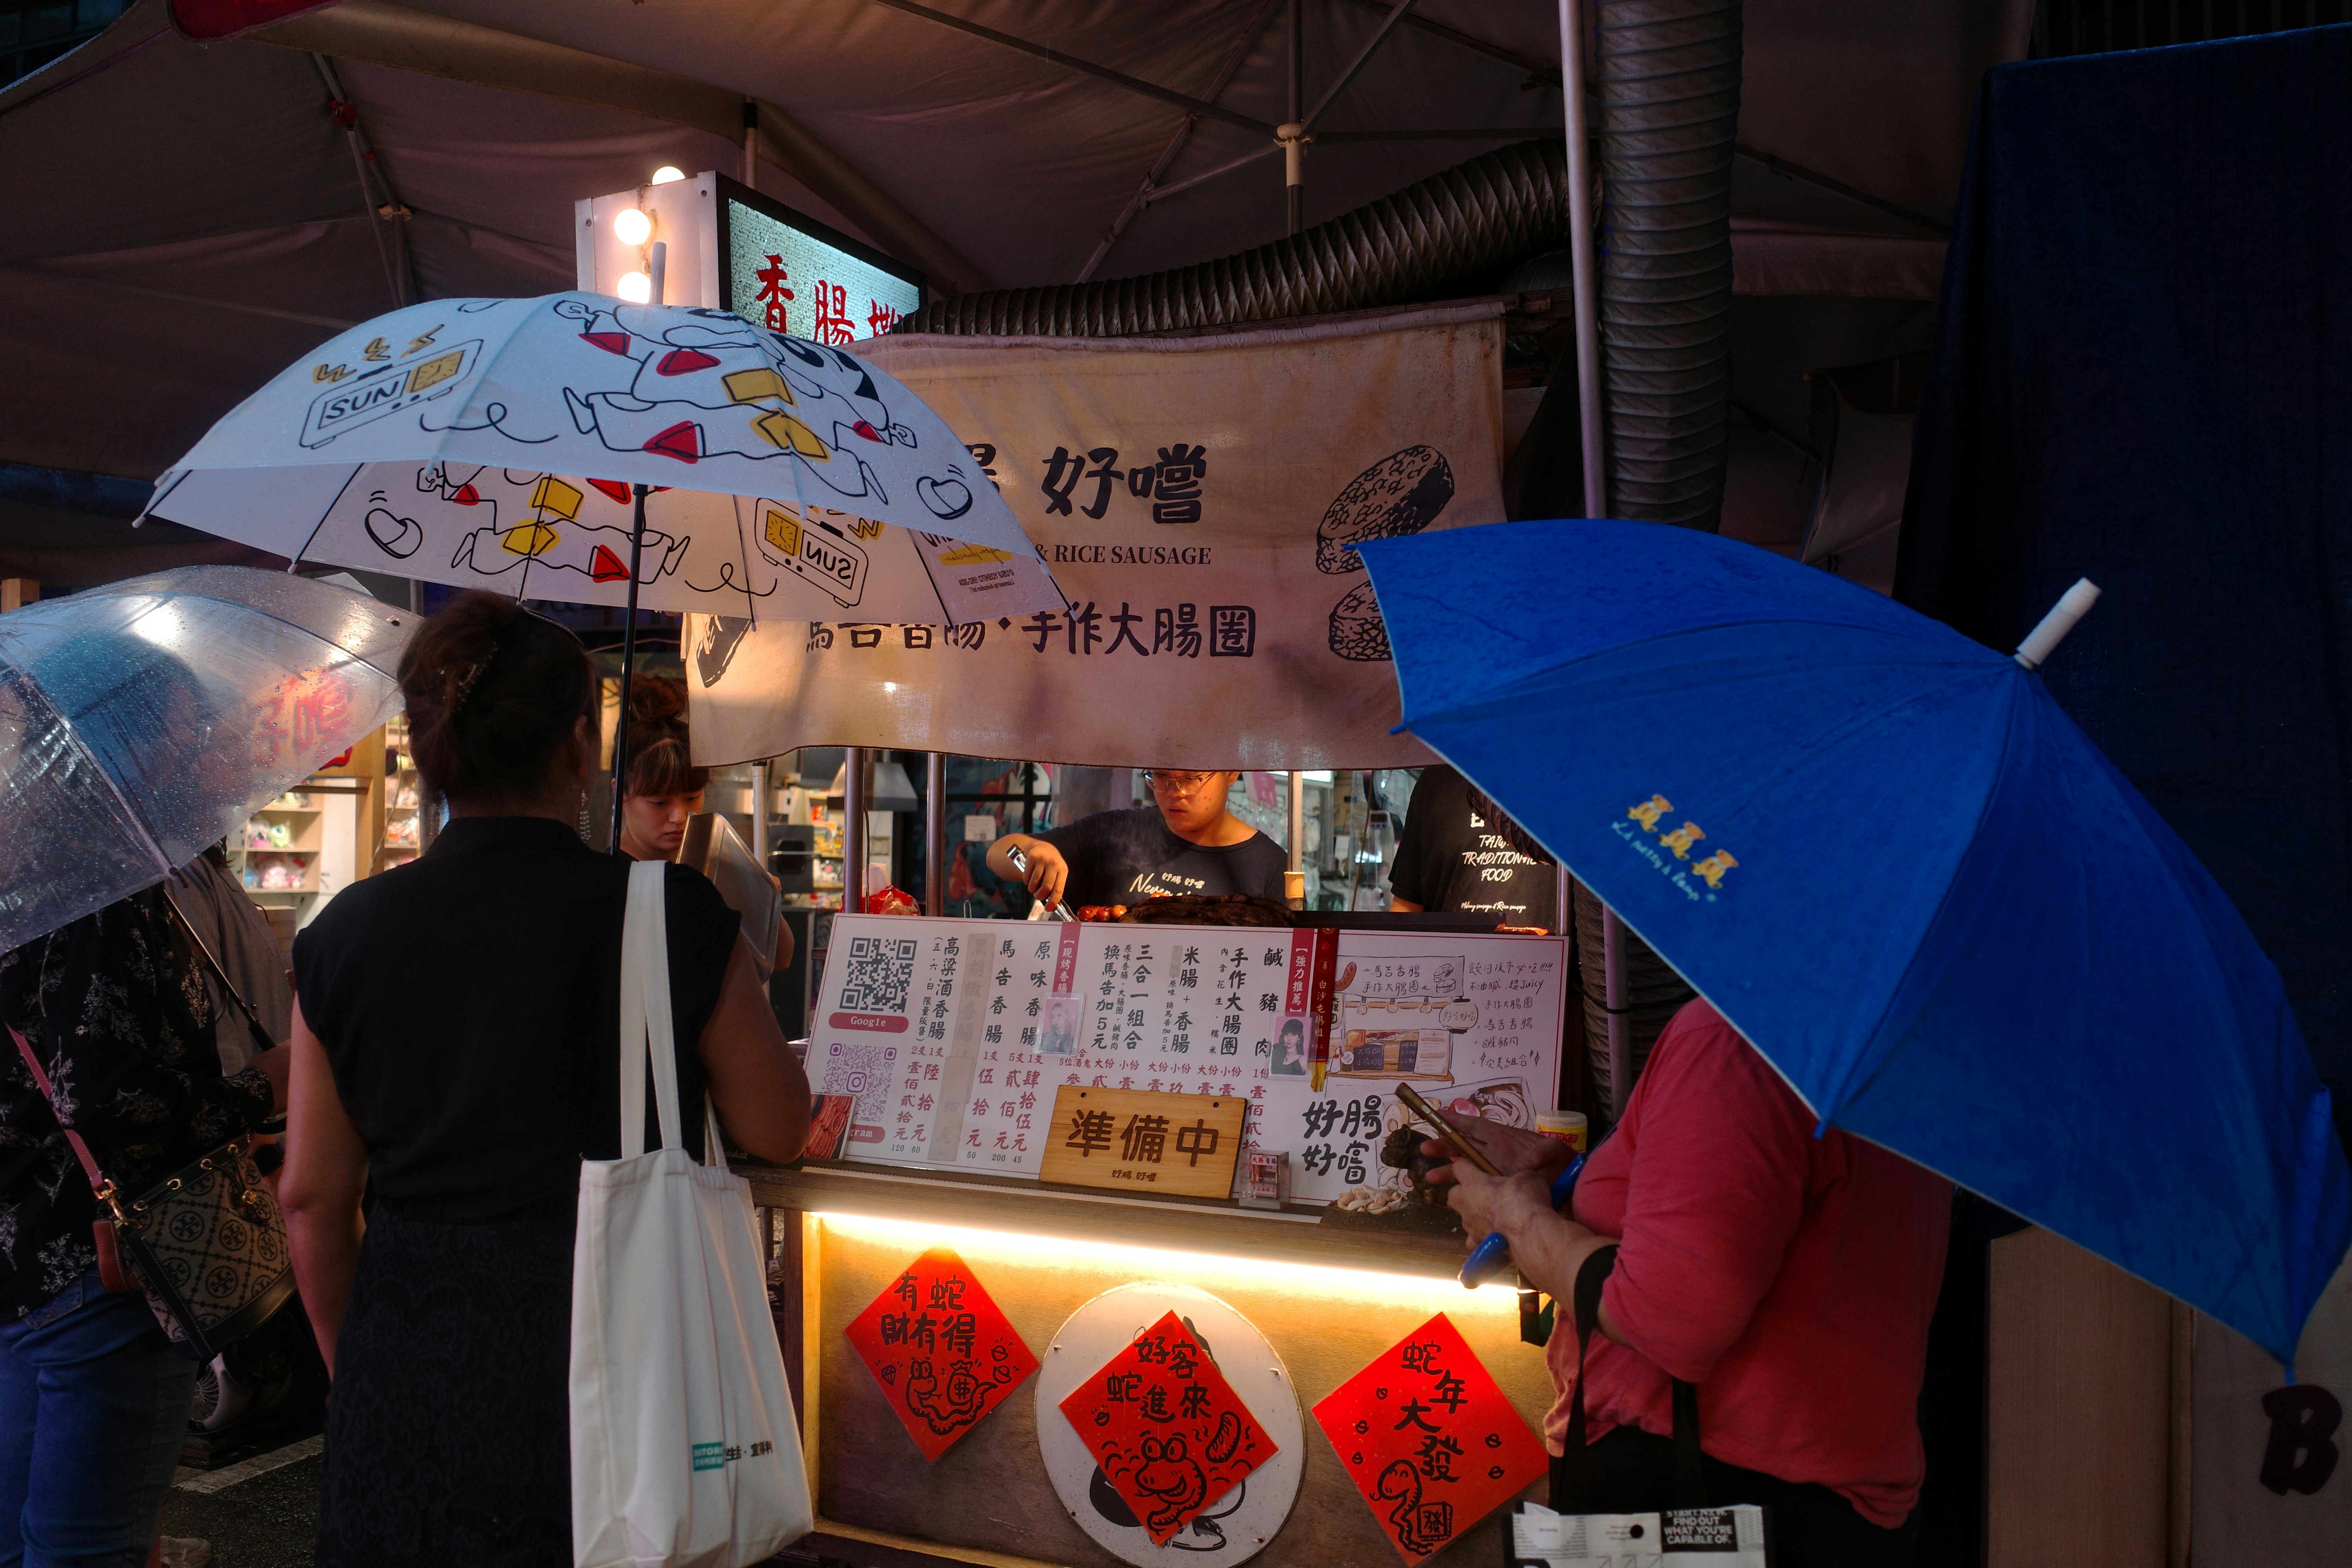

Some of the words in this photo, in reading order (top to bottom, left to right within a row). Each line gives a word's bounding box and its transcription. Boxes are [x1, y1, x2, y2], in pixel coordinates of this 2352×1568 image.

[325, 381, 399, 419] SUN
[1054, 545, 1105, 563] RICE
[1111, 546, 1212, 565] SAUSAGE
[1479, 835, 1510, 849] TAIW
[1462, 851, 1537, 867] TRADITIONAL
[1481, 868, 1513, 882] FOOD
[1496, 901, 1509, 911] Rice
[1371, 965, 1420, 978] 馬告香腸
[984, 940, 1015, 1044] 馬告香腸
[1020, 941, 1051, 1046] 原味香腸
[1091, 944, 1120, 1050] 換馬告加5元
[1123, 944, 1153, 1050] 三合一組合
[1363, 981, 1419, 996] 手作大腸圈
[1220, 947, 1249, 1056] 手作大腸圈
[1255, 947, 1283, 1057] 鹹豬肉
[1314, 980, 1327, 1037] 白沙屯媽祖
[1485, 996, 1532, 1010] 手作大腸圈
[851, 1016, 886, 1027] Google
[983, 1051, 999, 1061] 1支
[1094, 1058, 1114, 1069] 大份
[1120, 1060, 1140, 1071] 小份
[1148, 1062, 1169, 1073] 大份
[1171, 1063, 1192, 1074] 小份
[1197, 1064, 1219, 1076] 大份
[1220, 1065, 1242, 1077] 小份
[911, 1063, 940, 1142] 陸拾元
[965, 1068, 994, 1148] 伍拾元
[993, 1069, 1022, 1150] 貳佰元
[1011, 1070, 1041, 1152] 肆拾伍元
[1302, 1095, 1382, 1140] 好腸
[891, 1144, 904, 1152] 120
[1066, 1109, 1219, 1167] 準備中
[723, 1148, 750, 1159] arshall
[894, 1271, 966, 1312] 有蛇
[880, 1312, 976, 1359] 財有得
[1134, 1336, 1198, 1379] 好客
[1107, 1371, 1212, 1423] 蛇進來
[2259, 1385, 2342, 1496] B
[1664, 1526, 1693, 1535] WHAT
[1698, 1516, 1720, 1525] OUT
